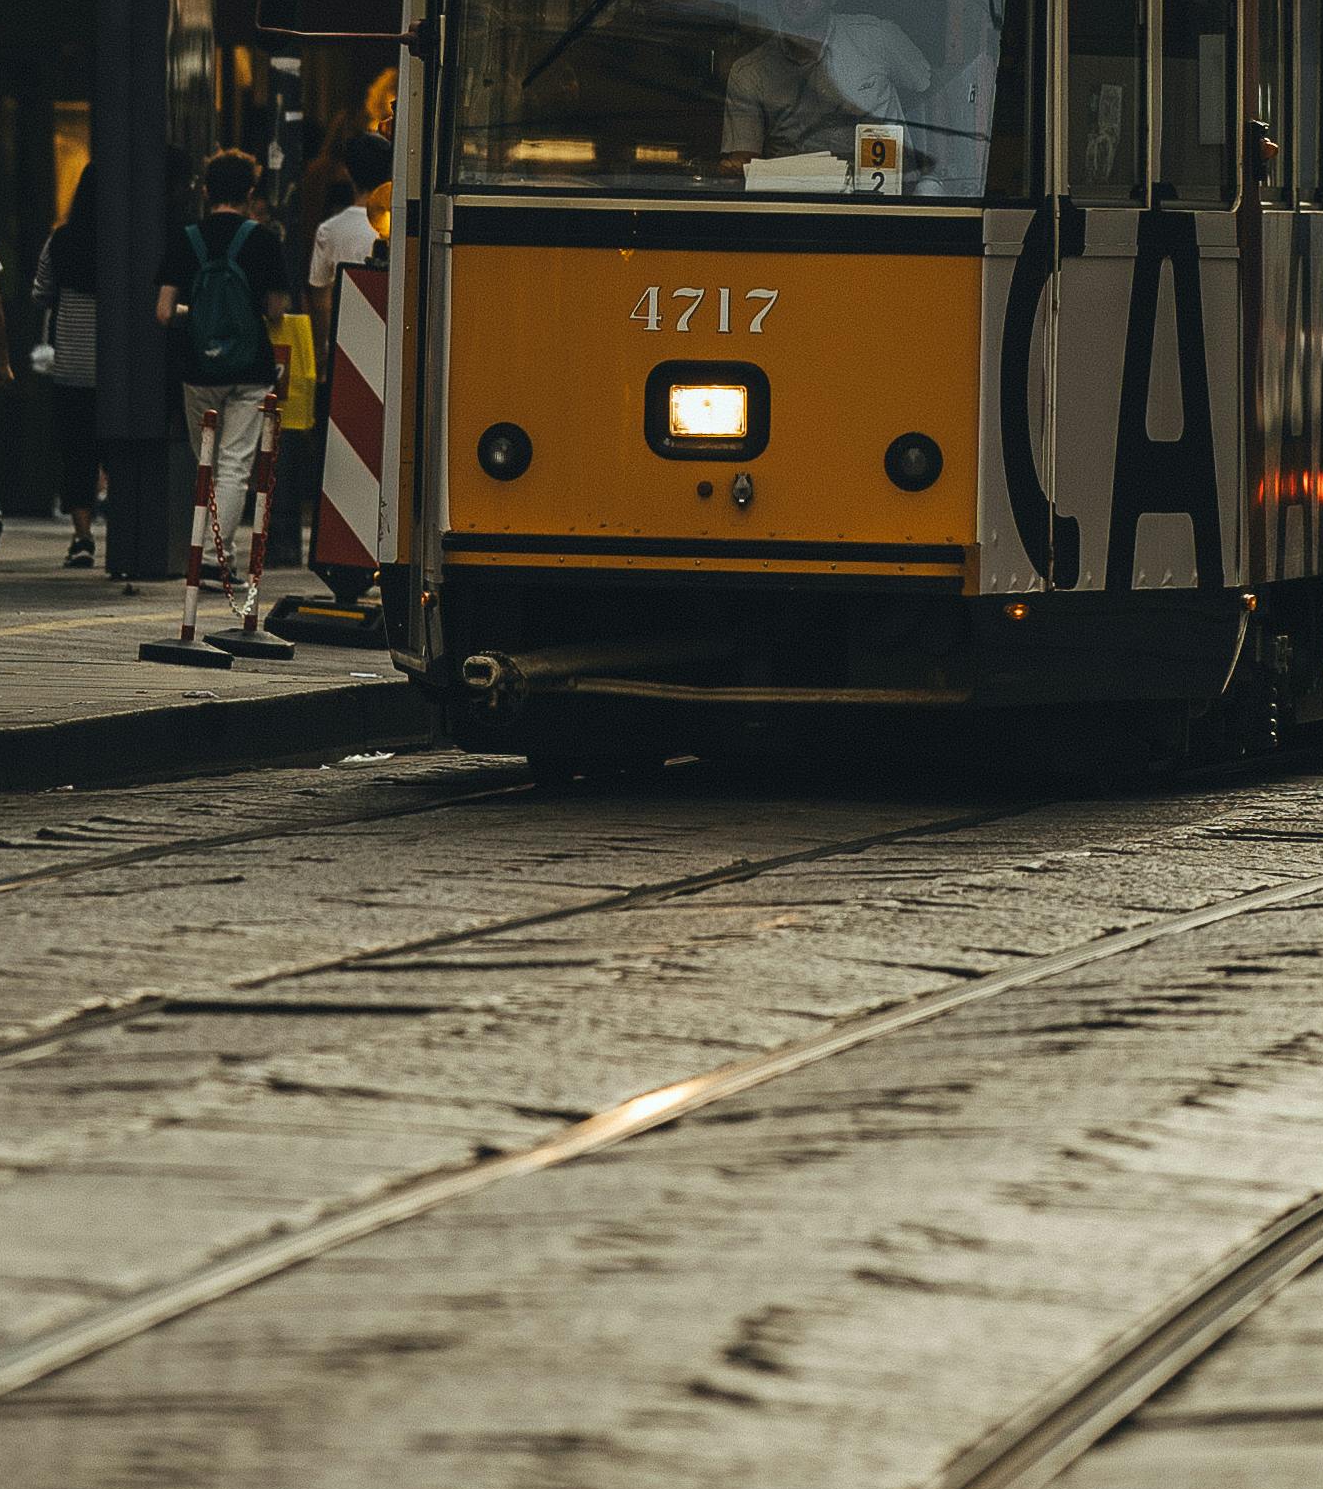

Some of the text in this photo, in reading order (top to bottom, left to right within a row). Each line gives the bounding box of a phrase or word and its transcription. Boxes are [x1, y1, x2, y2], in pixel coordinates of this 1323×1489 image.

[871, 140, 886, 167] 9
[870, 171, 885, 194] 2
[629, 286, 780, 333] 4717
